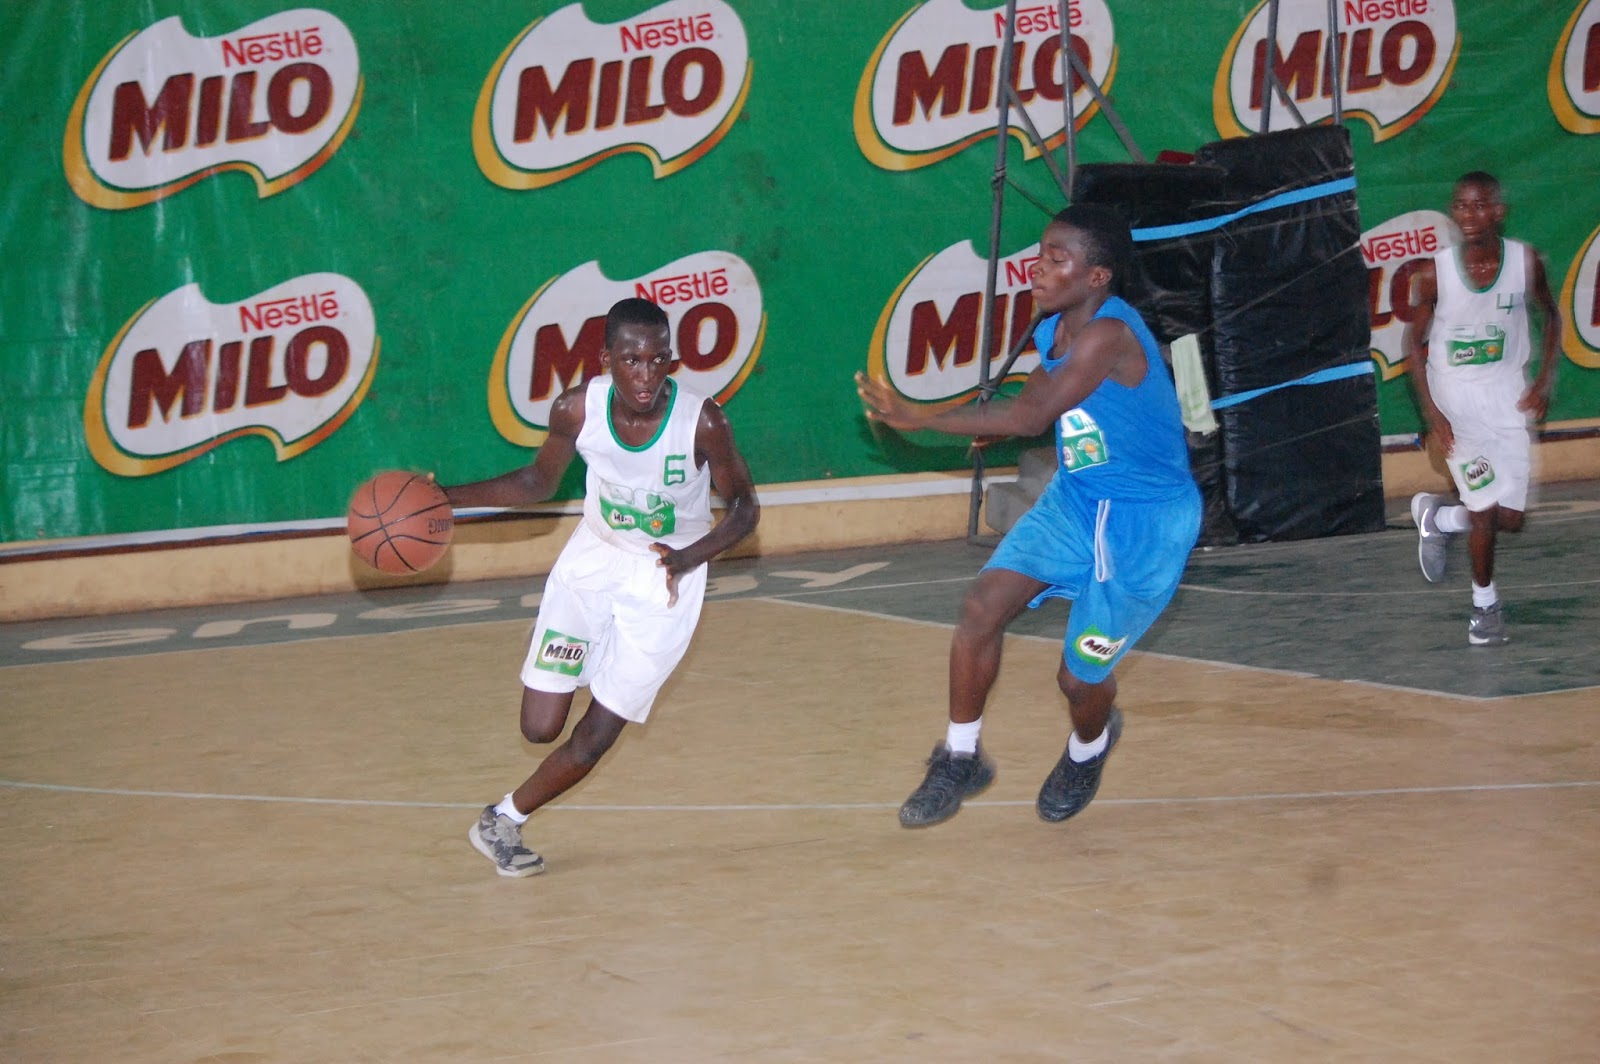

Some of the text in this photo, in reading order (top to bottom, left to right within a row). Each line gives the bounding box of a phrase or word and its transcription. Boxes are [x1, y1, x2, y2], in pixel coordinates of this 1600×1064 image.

[513, 47, 725, 144] MILO
[892, 33, 1092, 127] MILO
[1249, 20, 1437, 110] MILO
[108, 62, 333, 161] MILO
[905, 290, 1036, 376] MIL
[1369, 258, 1437, 329] LO
[1496, 293, 1514, 315] 4
[127, 325, 350, 430] MILO
[529, 301, 739, 402] MO
[663, 453, 687, 486] 6
[20, 561, 892, 651] eney
[1083, 638, 1119, 655] MILO
[544, 643, 583, 660] MILO
